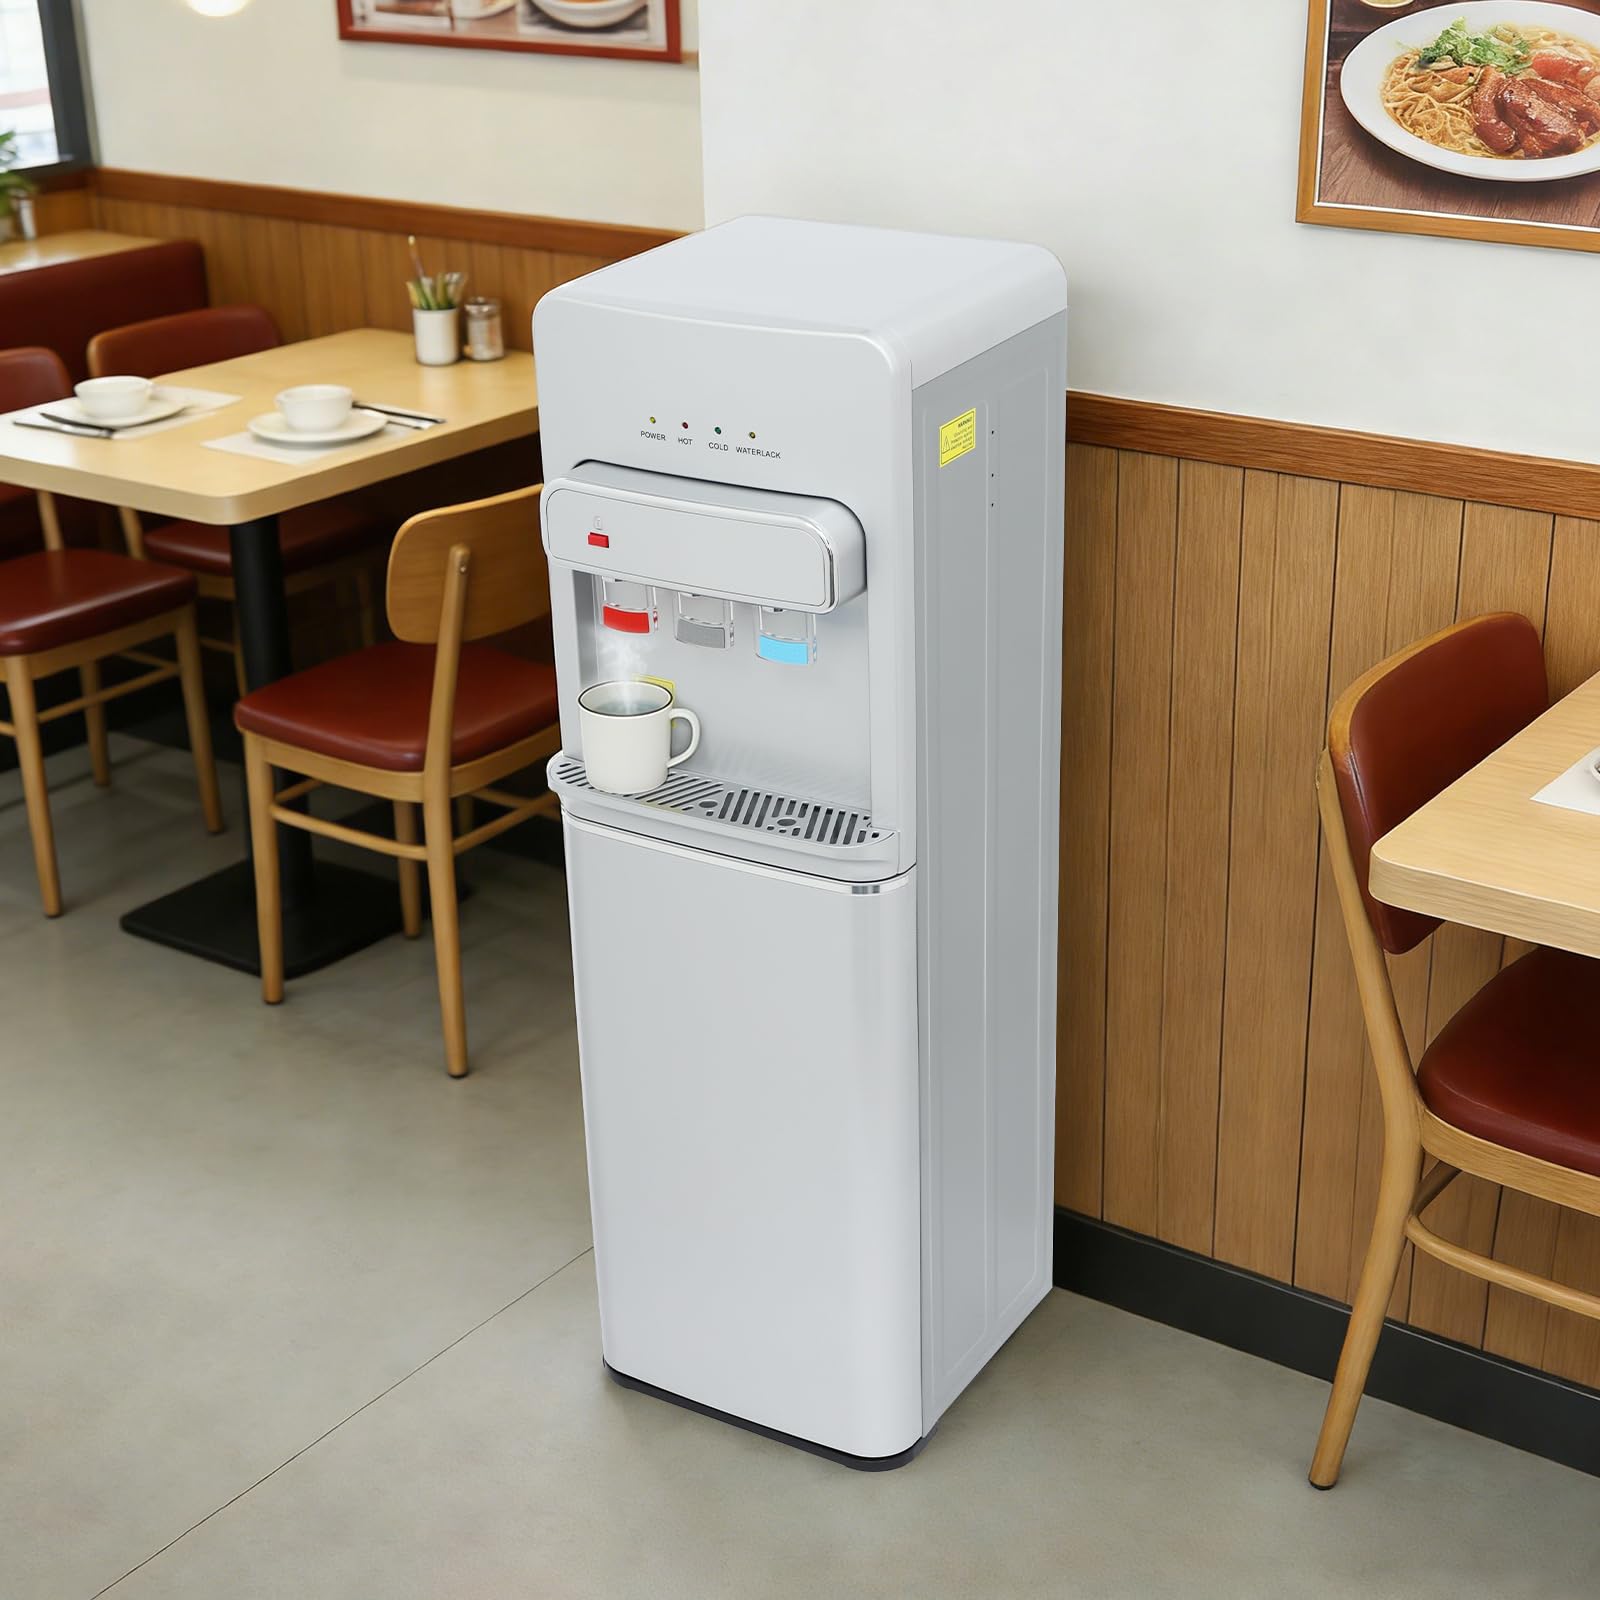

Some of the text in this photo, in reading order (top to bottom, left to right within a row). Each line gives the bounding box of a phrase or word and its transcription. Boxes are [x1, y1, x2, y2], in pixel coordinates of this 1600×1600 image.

[640, 431, 666, 441] POWER
[678, 437, 693, 446] HOT
[708, 442, 729, 452] COLD
[735, 446, 781, 459] WATERLACK
